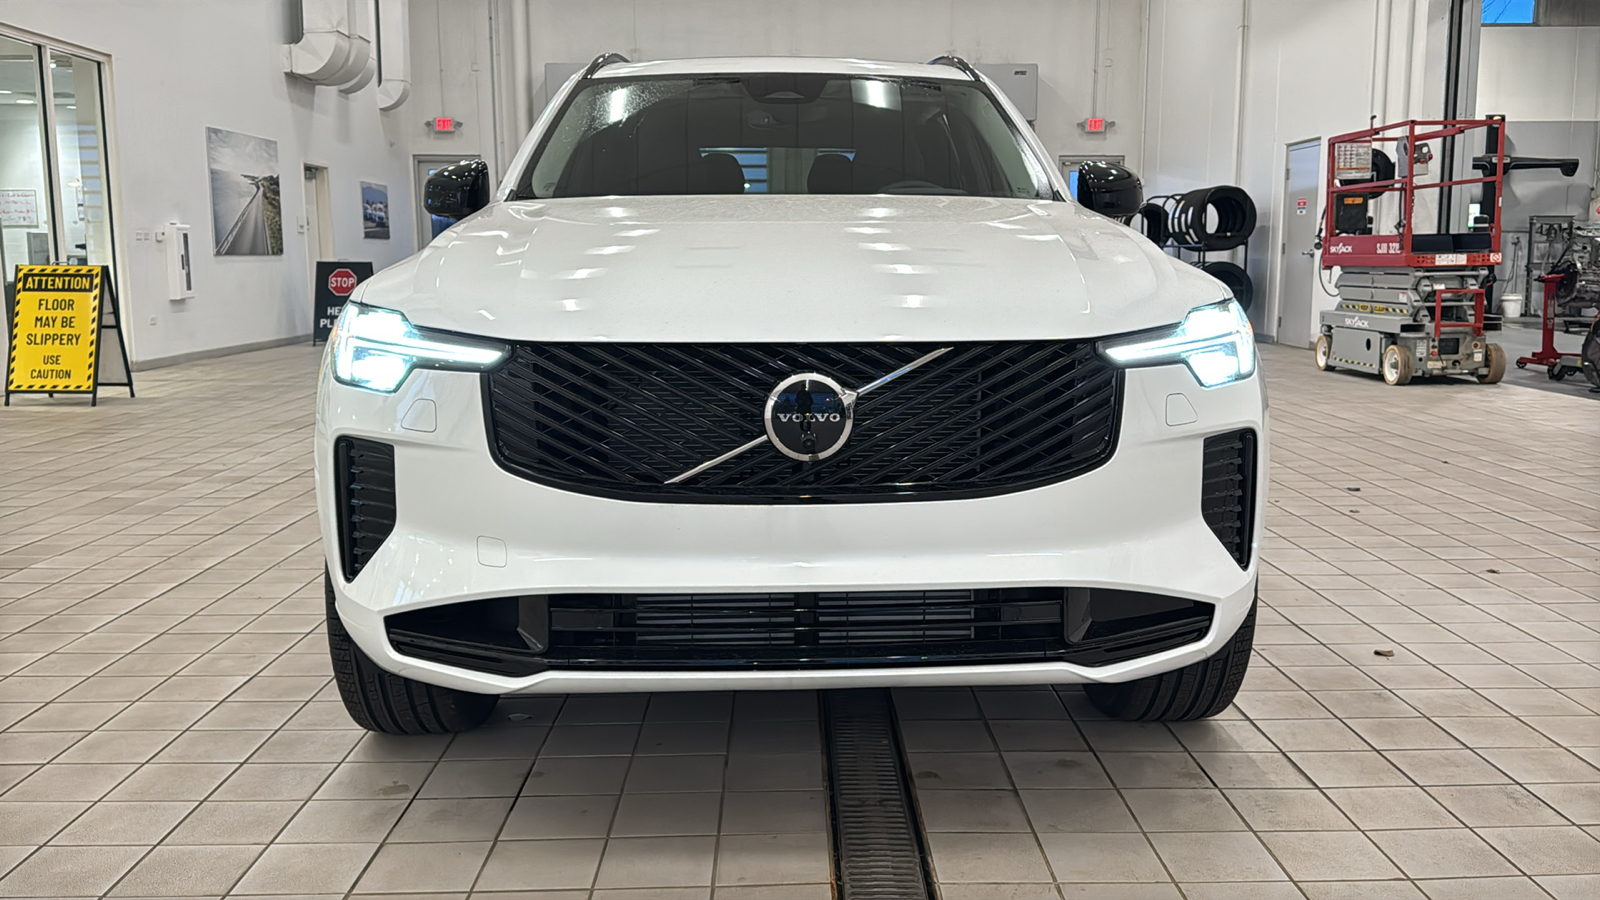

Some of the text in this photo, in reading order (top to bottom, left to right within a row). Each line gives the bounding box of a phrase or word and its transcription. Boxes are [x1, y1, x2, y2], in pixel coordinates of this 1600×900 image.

[436, 117, 452, 130] EXIT
[1329, 243, 1353, 254] SKYJACK
[26, 276, 90, 289] ATTENTION
[331, 277, 354, 287] STOP
[37, 298, 75, 311] FLOOR
[327, 306, 342, 316] HE
[34, 316, 76, 329] MAY BE
[26, 333, 81, 345] SLIPPERY
[42, 354, 62, 365] USE
[30, 368, 72, 380] CAUTION
[777, 413, 840, 422] VOLVO
